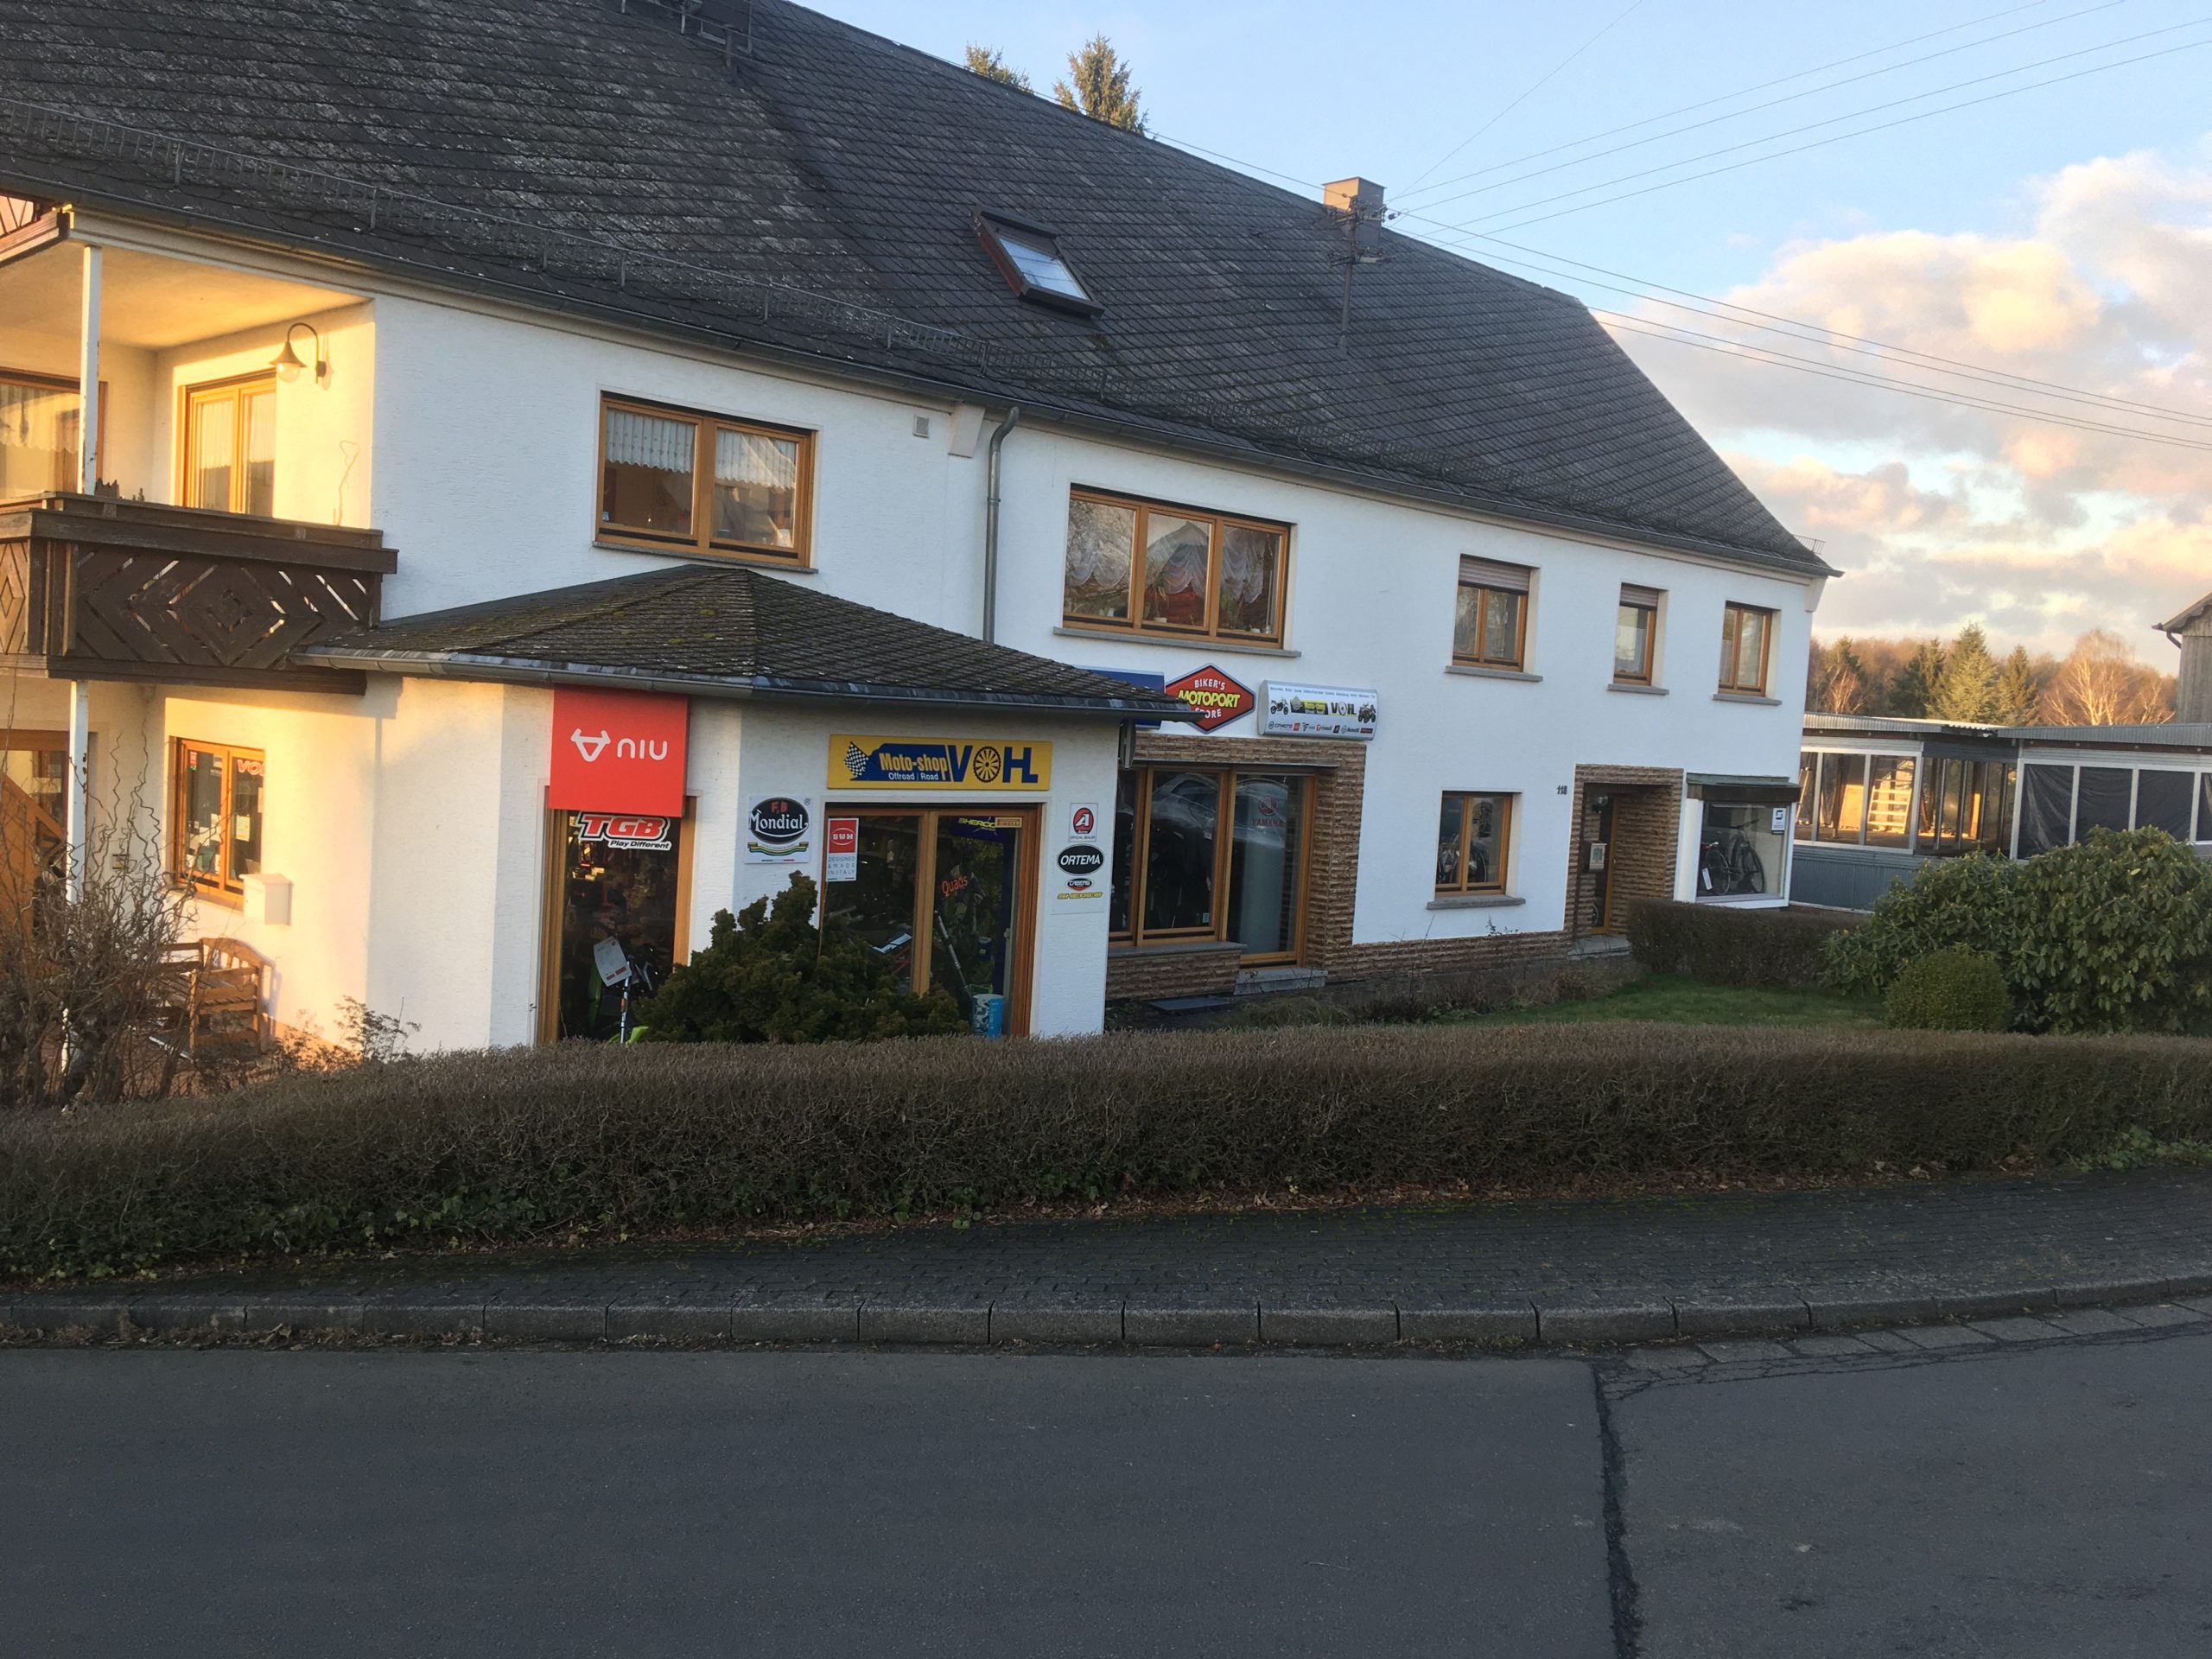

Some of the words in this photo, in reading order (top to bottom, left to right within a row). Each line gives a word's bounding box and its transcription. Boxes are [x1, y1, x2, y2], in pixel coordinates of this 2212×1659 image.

[1194, 678, 1225, 690] BIKER'S
[1178, 690, 1240, 708] MOTOPORT
[617, 738, 668, 760] niu
[237, 759, 264, 777] VO
[879, 753, 948, 781] Moto-shop
[888, 772, 915, 781] Offroad
[920, 772, 939, 781] Road
[580, 814, 667, 838] TGB
[749, 809, 807, 834] Mondial
[610, 840, 630, 849] Play
[630, 841, 670, 850] Different
[1060, 855, 1101, 866] ORTEMA
[941, 873, 968, 897] Quads
